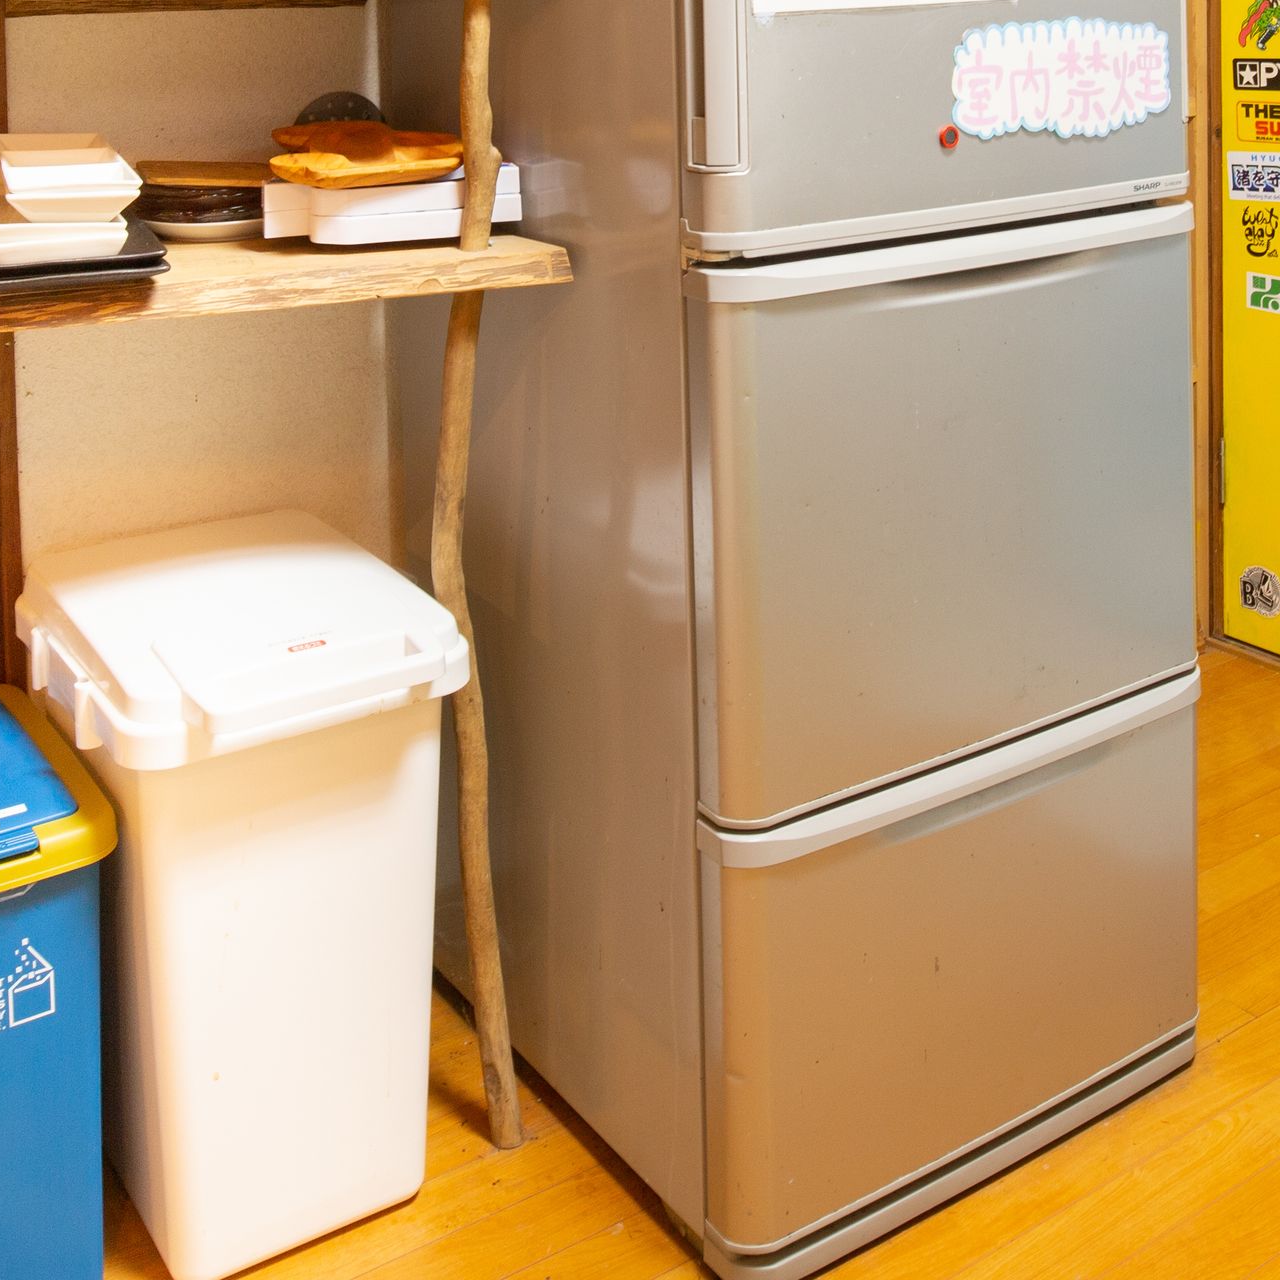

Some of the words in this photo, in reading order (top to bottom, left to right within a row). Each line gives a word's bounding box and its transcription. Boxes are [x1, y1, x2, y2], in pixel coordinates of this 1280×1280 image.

[957, 37, 1168, 126] 室内禁煙
[1133, 182, 1161, 192] SHARP
